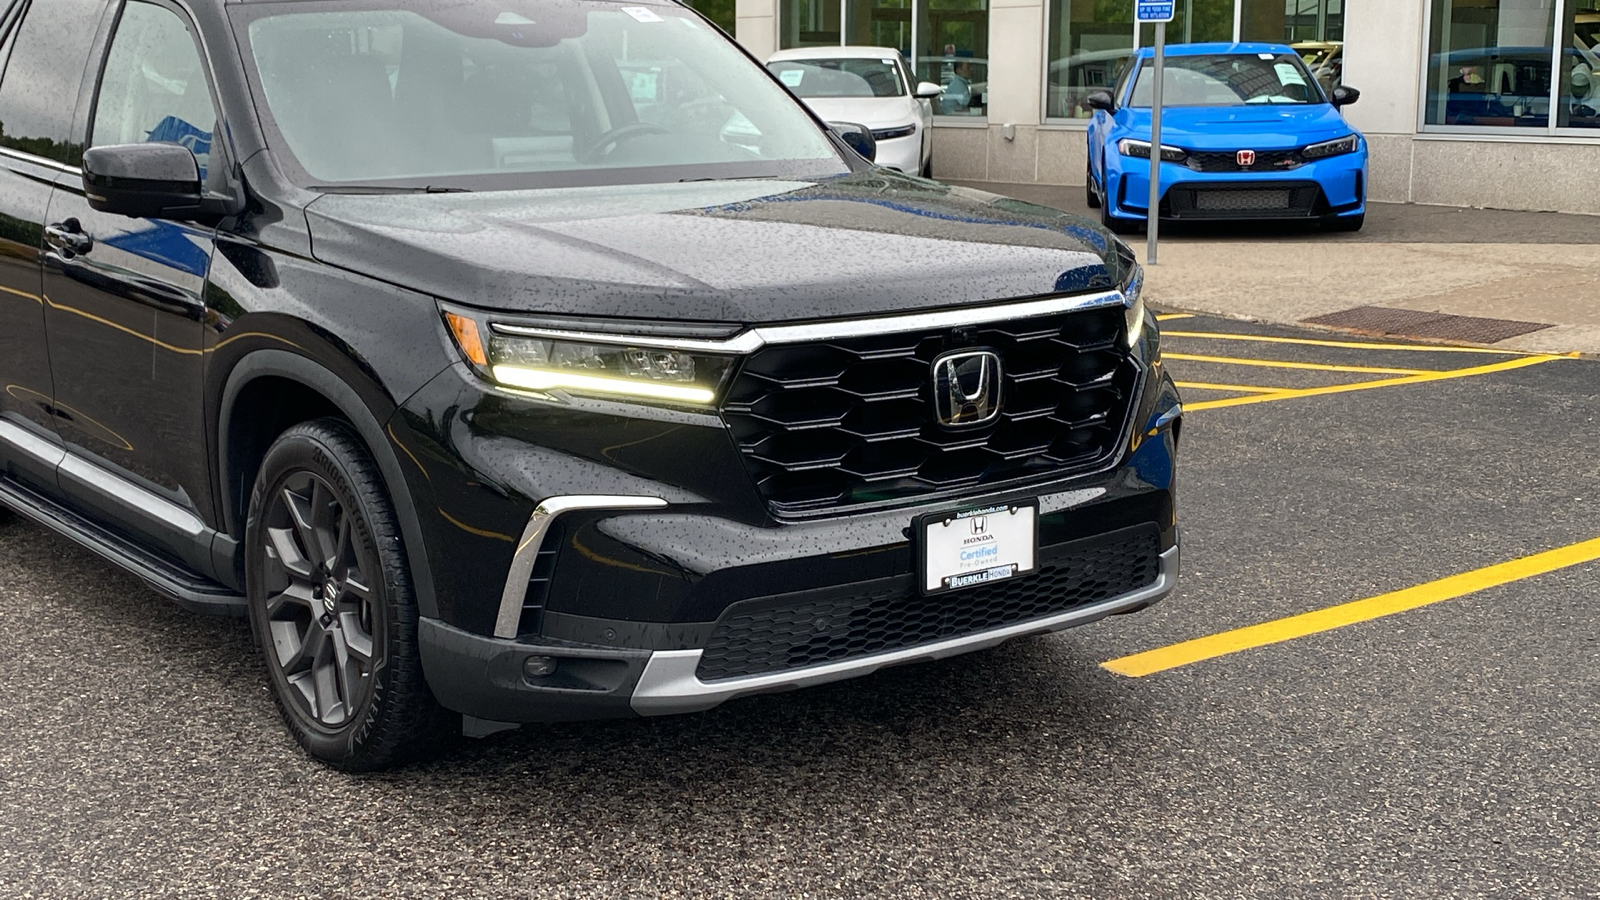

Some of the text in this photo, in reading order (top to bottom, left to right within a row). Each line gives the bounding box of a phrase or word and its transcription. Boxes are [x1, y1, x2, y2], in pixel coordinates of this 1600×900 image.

[963, 534, 994, 544] HONDA
[960, 545, 998, 561] Certified
[960, 556, 998, 568] Pre-Owned
[951, 568, 1011, 587] BUERKLE HONDA
[355, 677, 384, 745] ALENZA
